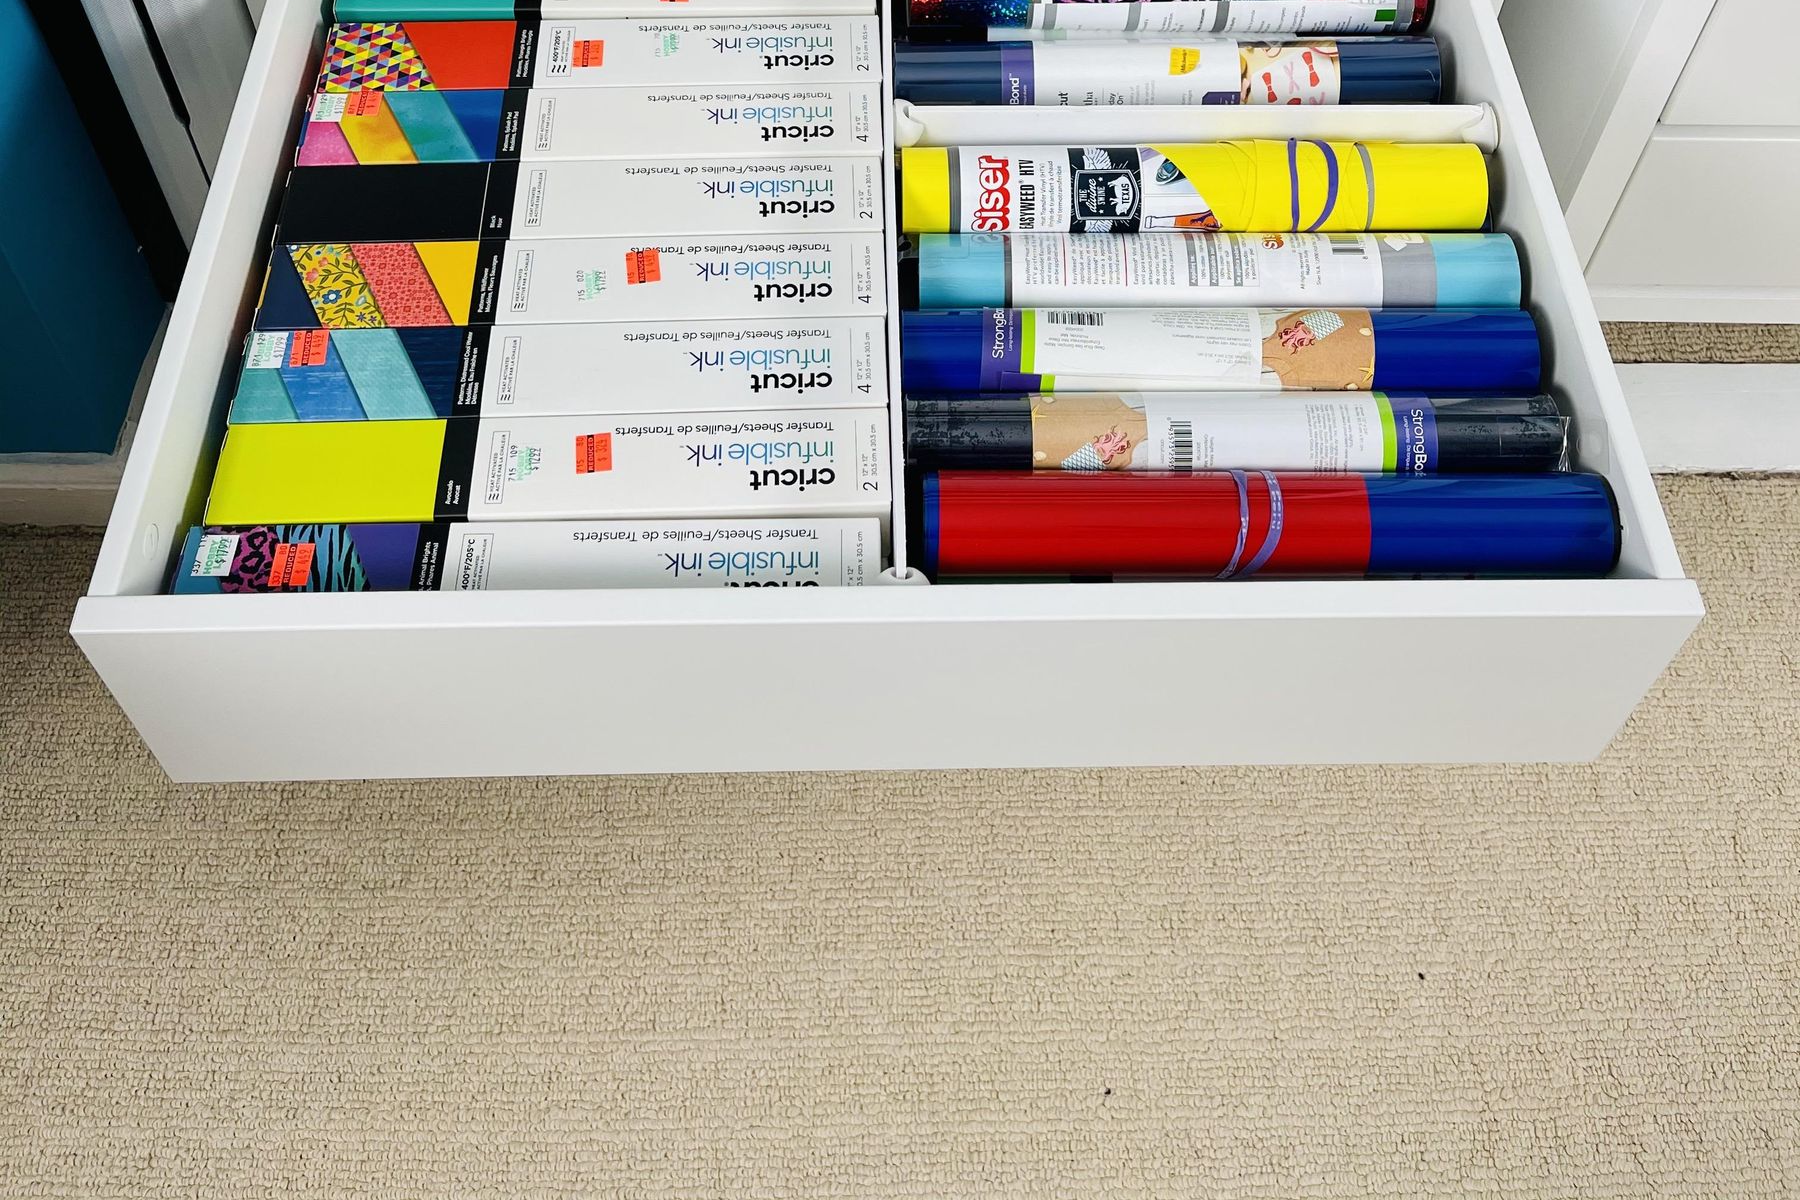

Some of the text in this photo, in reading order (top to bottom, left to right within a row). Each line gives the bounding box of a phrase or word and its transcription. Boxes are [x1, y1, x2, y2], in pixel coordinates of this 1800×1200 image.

[638, 23, 832, 33] Transfer Sheets/Feuilles de Transferts
[746, 36, 833, 52] infusible
[763, 54, 834, 71] cricut
[647, 92, 832, 103] Transfer Sheets/Feuilles de Transferts
[742, 106, 832, 122] infusible
[761, 126, 834, 142] cricut
[856, 134, 869, 142] 4
[625, 164, 832, 176] Transfer Sheets/Feuilles de Transferts
[1019, 160, 1034, 175] HTV
[740, 179, 833, 198] infusible
[971, 155, 1010, 231] Siser
[1079, 189, 1087, 202] THE
[1085, 178, 1096, 213] divine
[1122, 183, 1130, 204] TEXAS
[759, 200, 835, 218] cricut
[860, 211, 872, 219] 2
[688, 246, 701, 255] de
[705, 245, 785, 254] Sheets/Feuilles
[788, 243, 831, 253] Transfer
[734, 260, 831, 280] infusible
[754, 283, 832, 303] cricut
[858, 295, 872, 304] 4
[624, 329, 831, 343] Transfer Sheets/Feuilles de Transferts
[303, 333, 311, 363] REDUCED
[730, 349, 831, 371] infusible
[751, 372, 832, 394] cricut
[857, 384, 872, 393] 4
[615, 421, 834, 437] Transfer Sheets/Feuilles de Transferts
[728, 441, 833, 465] infusible
[490, 453, 498, 478] ACTIVATED
[750, 468, 835, 491] cricut
[863, 482, 878, 491] 2
[445, 480, 453, 504] Avocado
[453, 485, 461, 504] Avocat
[573, 528, 818, 543] Transfer Sheets/Feuilles de Transferts
[203, 540, 217, 574] HOBBY
[283, 547, 296, 583] REDUCED
[419, 542, 431, 585] Animal Brights
[709, 551, 819, 575] infusible
[426, 565, 435, 585] Phares
